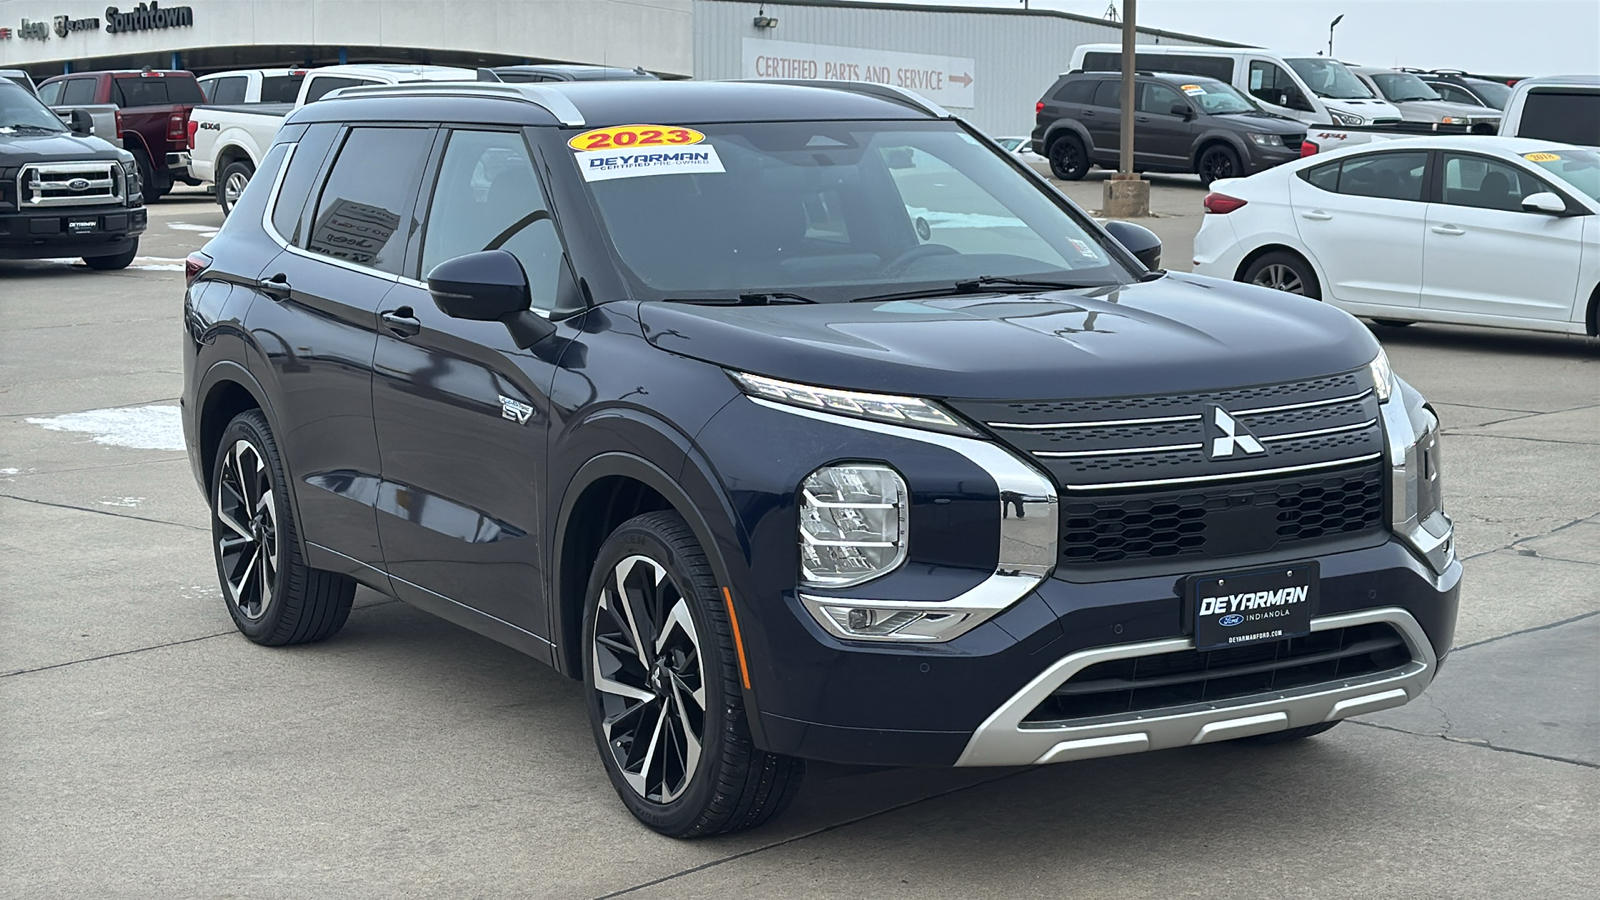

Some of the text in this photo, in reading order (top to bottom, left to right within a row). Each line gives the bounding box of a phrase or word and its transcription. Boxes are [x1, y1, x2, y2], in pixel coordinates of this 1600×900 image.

[66, 18, 99, 32] RAM
[105, 1, 193, 33] Southtown
[755, 55, 943, 90] CERTIFIED PARTS AND SERVICE
[586, 129, 691, 149] 2023
[589, 152, 709, 168] DEYARMAN
[600, 159, 709, 171] CERTIFIED PRE-OWNED
[1199, 585, 1309, 616] DEYARMAN
[1246, 609, 1290, 621] INDIANOLA
[1228, 629, 1283, 643] DEYARMANFORD.COM
